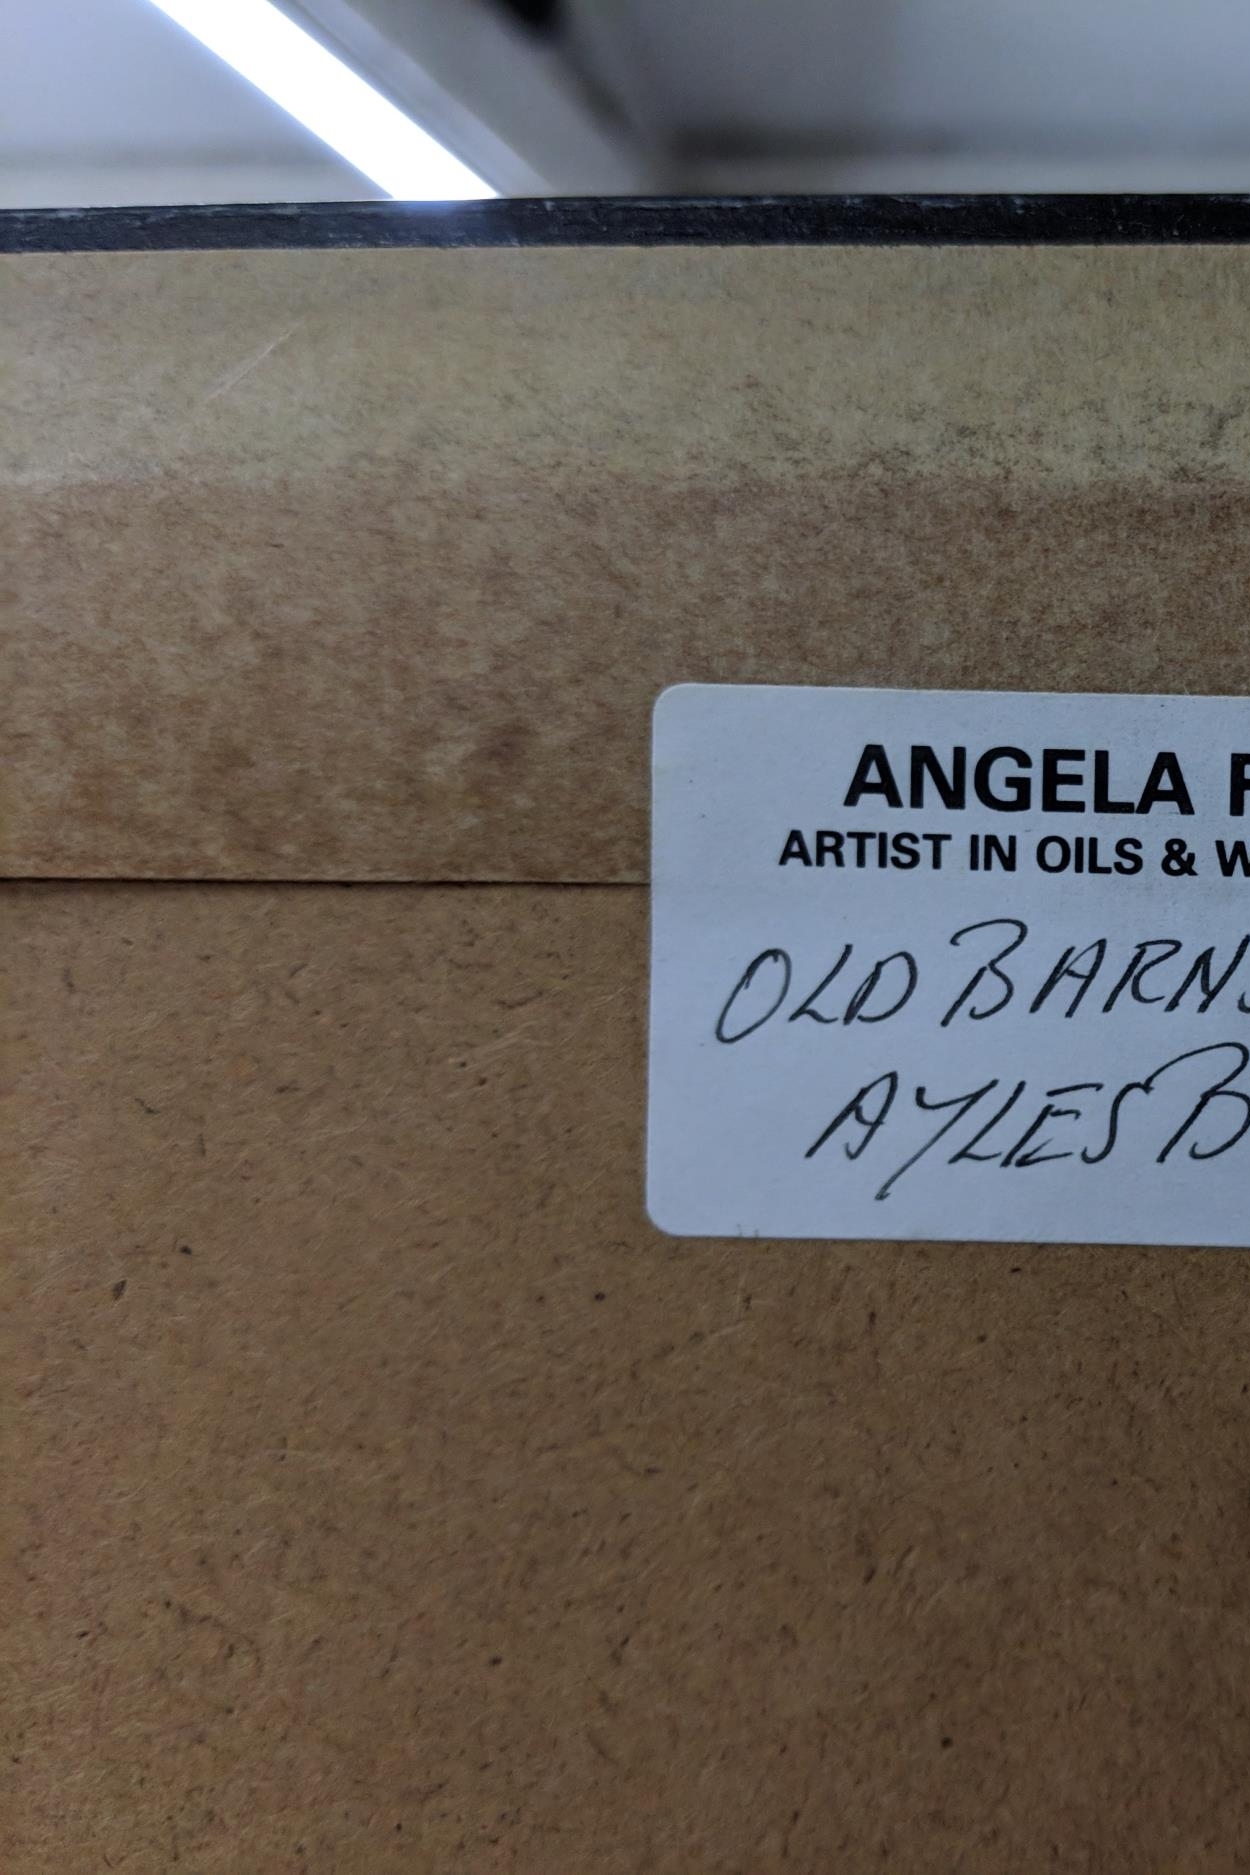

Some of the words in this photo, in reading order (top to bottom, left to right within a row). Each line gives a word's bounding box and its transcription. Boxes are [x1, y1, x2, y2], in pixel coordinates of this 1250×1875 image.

[842, 743, 1196, 816] ANGELA
[778, 828, 953, 871] ARTIST
[969, 833, 1017, 873] IN
[1035, 835, 1144, 876] OILS
[1160, 837, 1199, 877] &
[714, 943, 919, 1045] OLD
